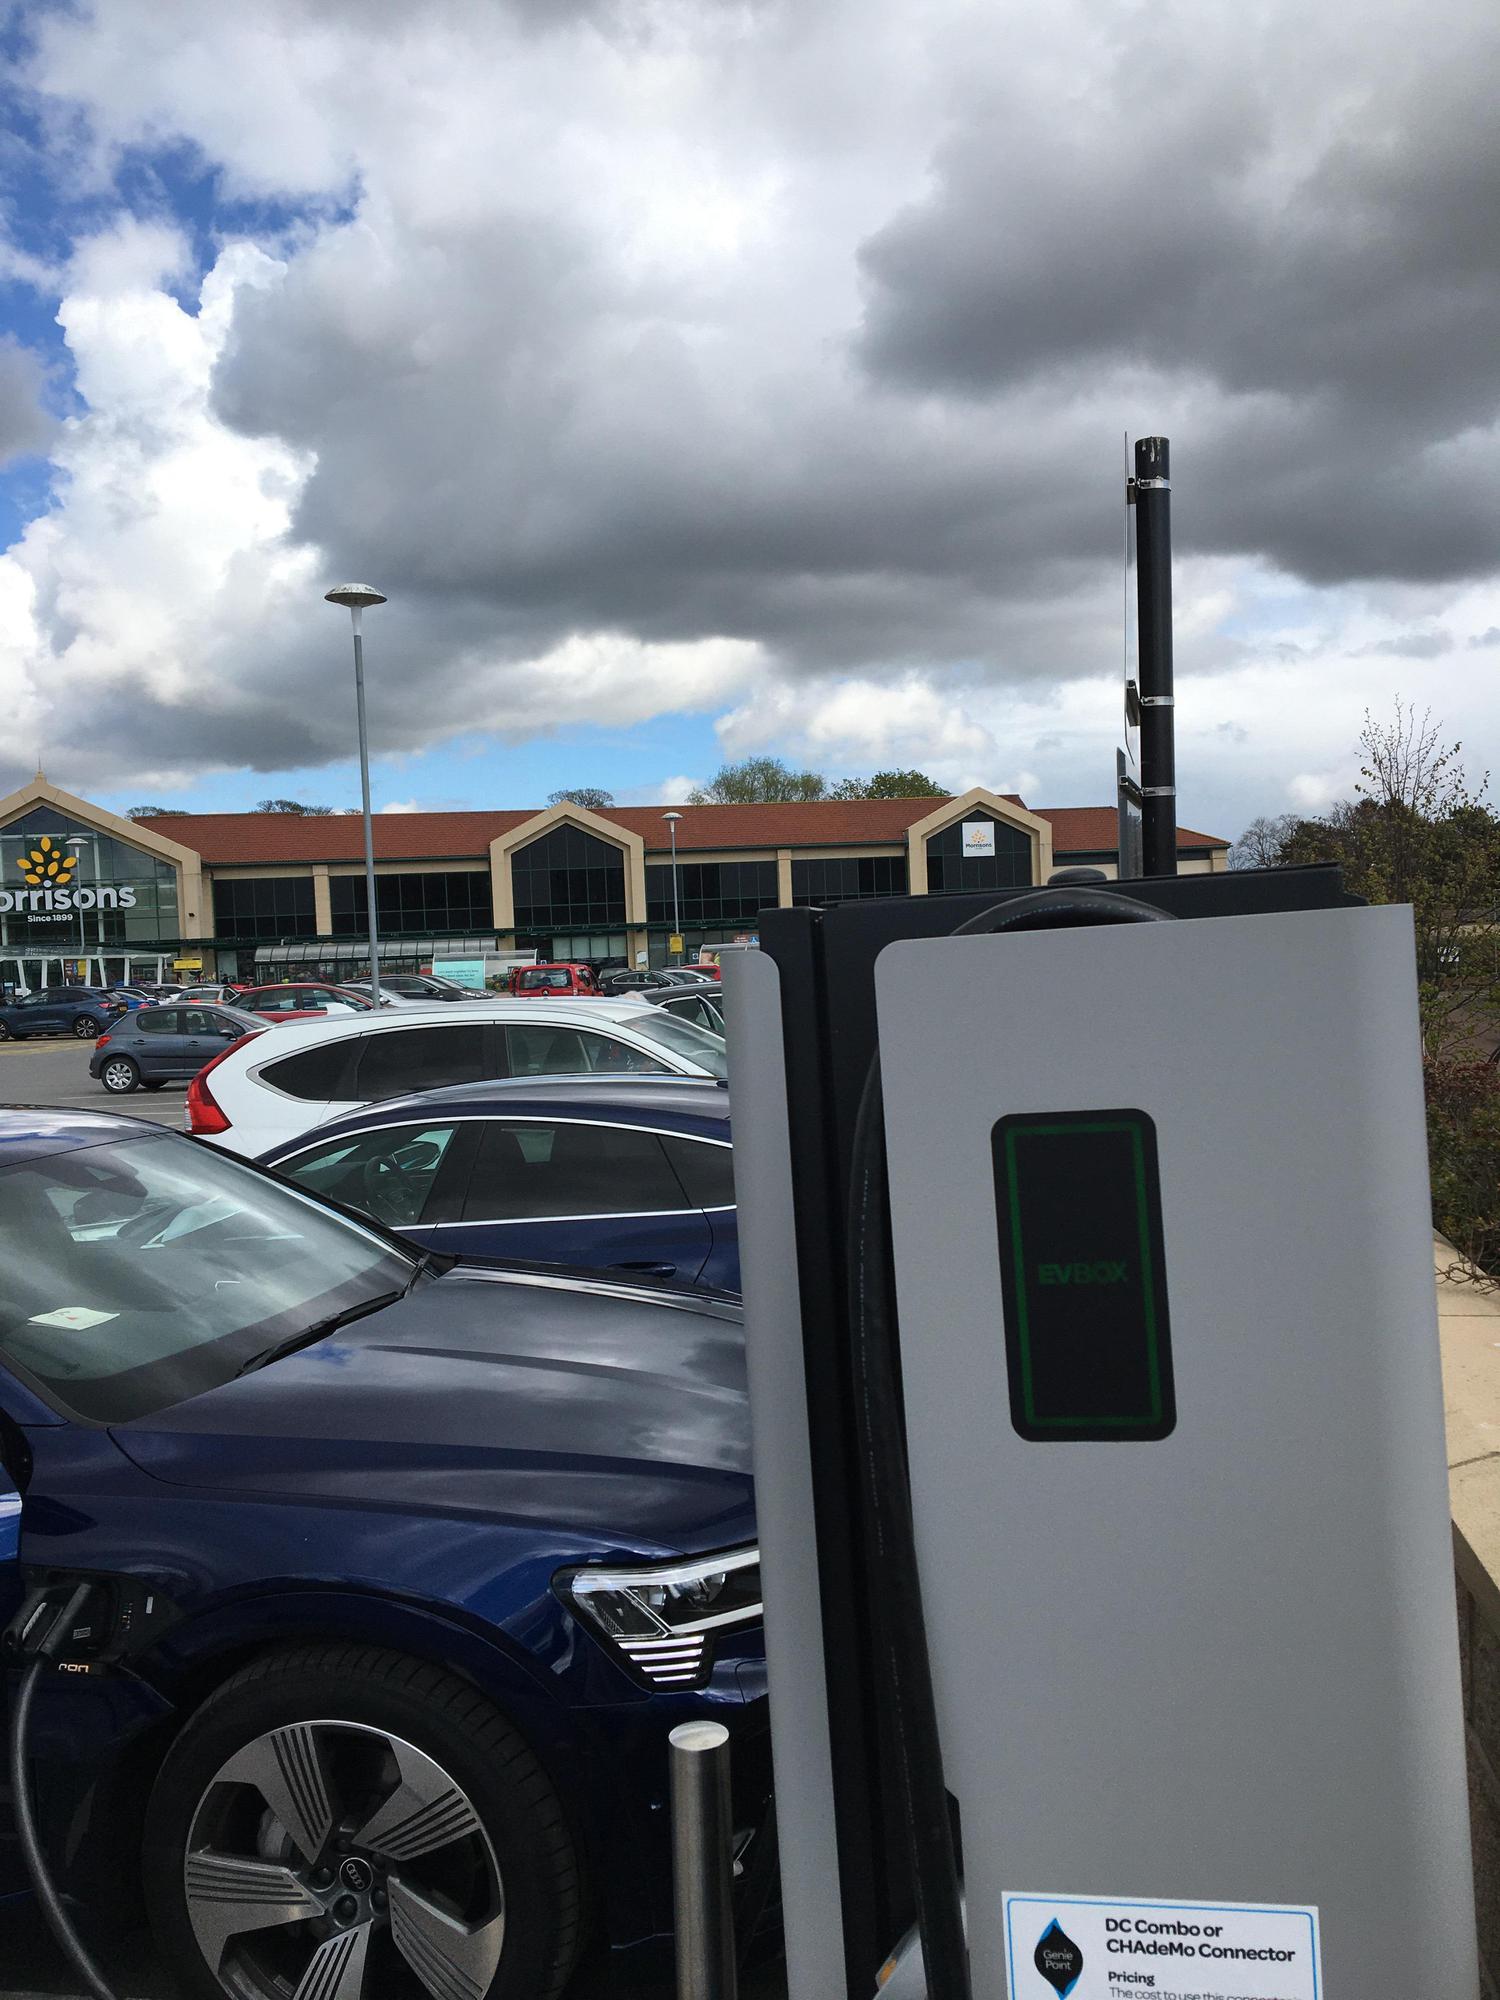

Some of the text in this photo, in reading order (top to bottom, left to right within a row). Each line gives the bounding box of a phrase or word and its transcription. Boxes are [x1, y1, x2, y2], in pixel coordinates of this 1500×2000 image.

[0, 880, 137, 913] orrisons
[27, 913, 74, 923] Since 1899
[1038, 1261, 1129, 1285] EVBOX
[1105, 1918, 1223, 1938] DC Combo or
[1043, 1948, 1074, 1961] Genie
[1106, 1938, 1296, 1962] CHAdeMo Connector
[1045, 1960, 1073, 1971] Point
[1108, 1971, 1155, 1987] Pricing
[1109, 1986, 1133, 1999] The
[1134, 1990, 1162, 2000] cost
[1163, 1991, 1177, 2000] to
